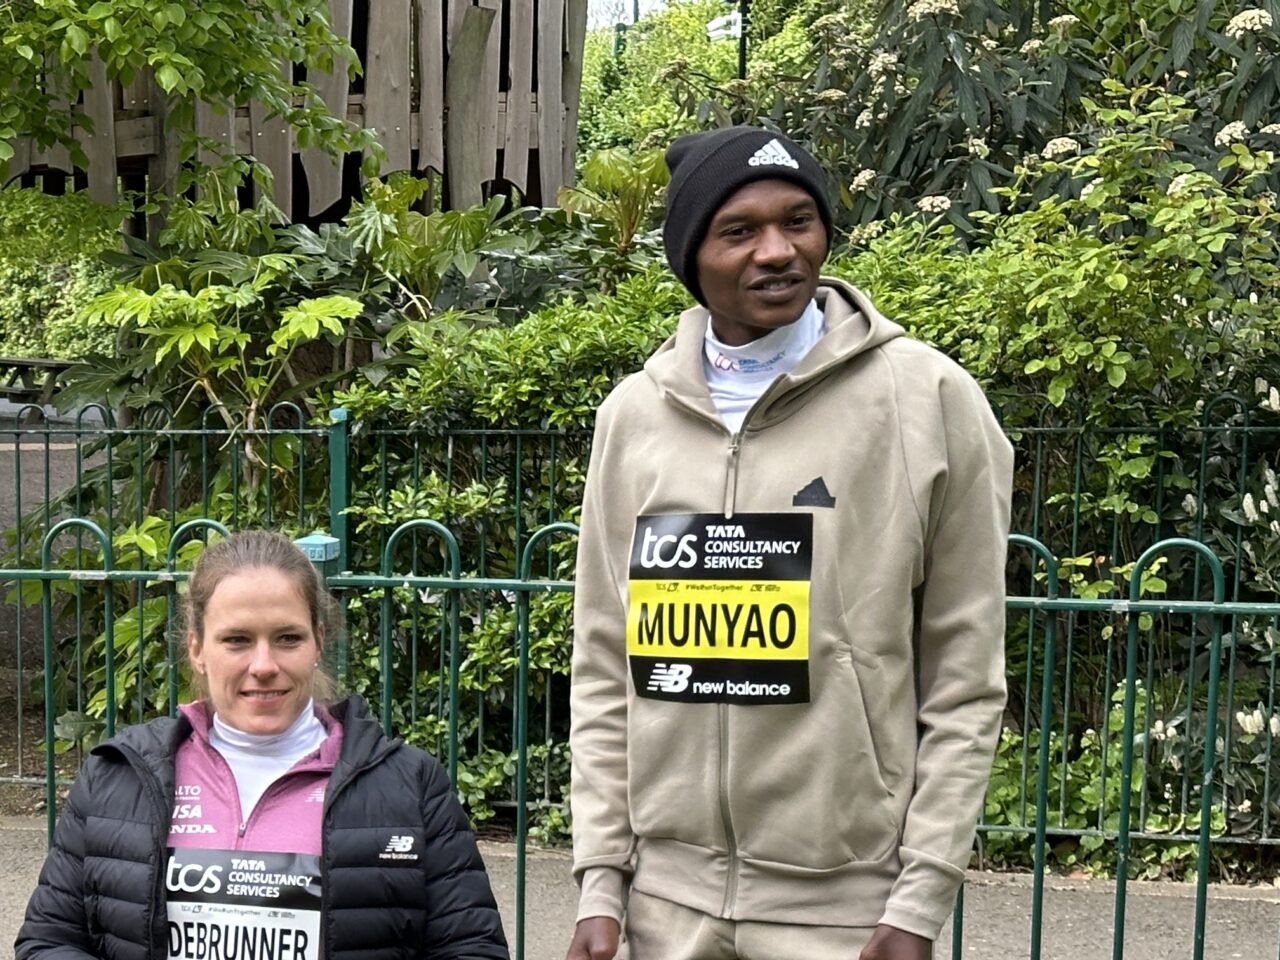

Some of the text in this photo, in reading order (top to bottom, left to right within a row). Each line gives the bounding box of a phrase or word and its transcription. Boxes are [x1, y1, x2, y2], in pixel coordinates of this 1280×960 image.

[748, 153, 799, 169] adidas
[705, 525, 746, 538] TATA
[640, 526, 698, 569] tcs
[704, 540, 801, 555] CONSULTANCY
[703, 555, 763, 569] SERVICES
[637, 602, 797, 650] MUNYAO
[692, 679, 791, 696] new balance
[172, 804, 202, 819] ISA
[168, 824, 218, 834] NDA
[230, 859, 266, 871] TATA
[165, 855, 224, 894] tcs
[228, 872, 313, 887] CONSULTANCY
[226, 884, 280, 898] SERVICES
